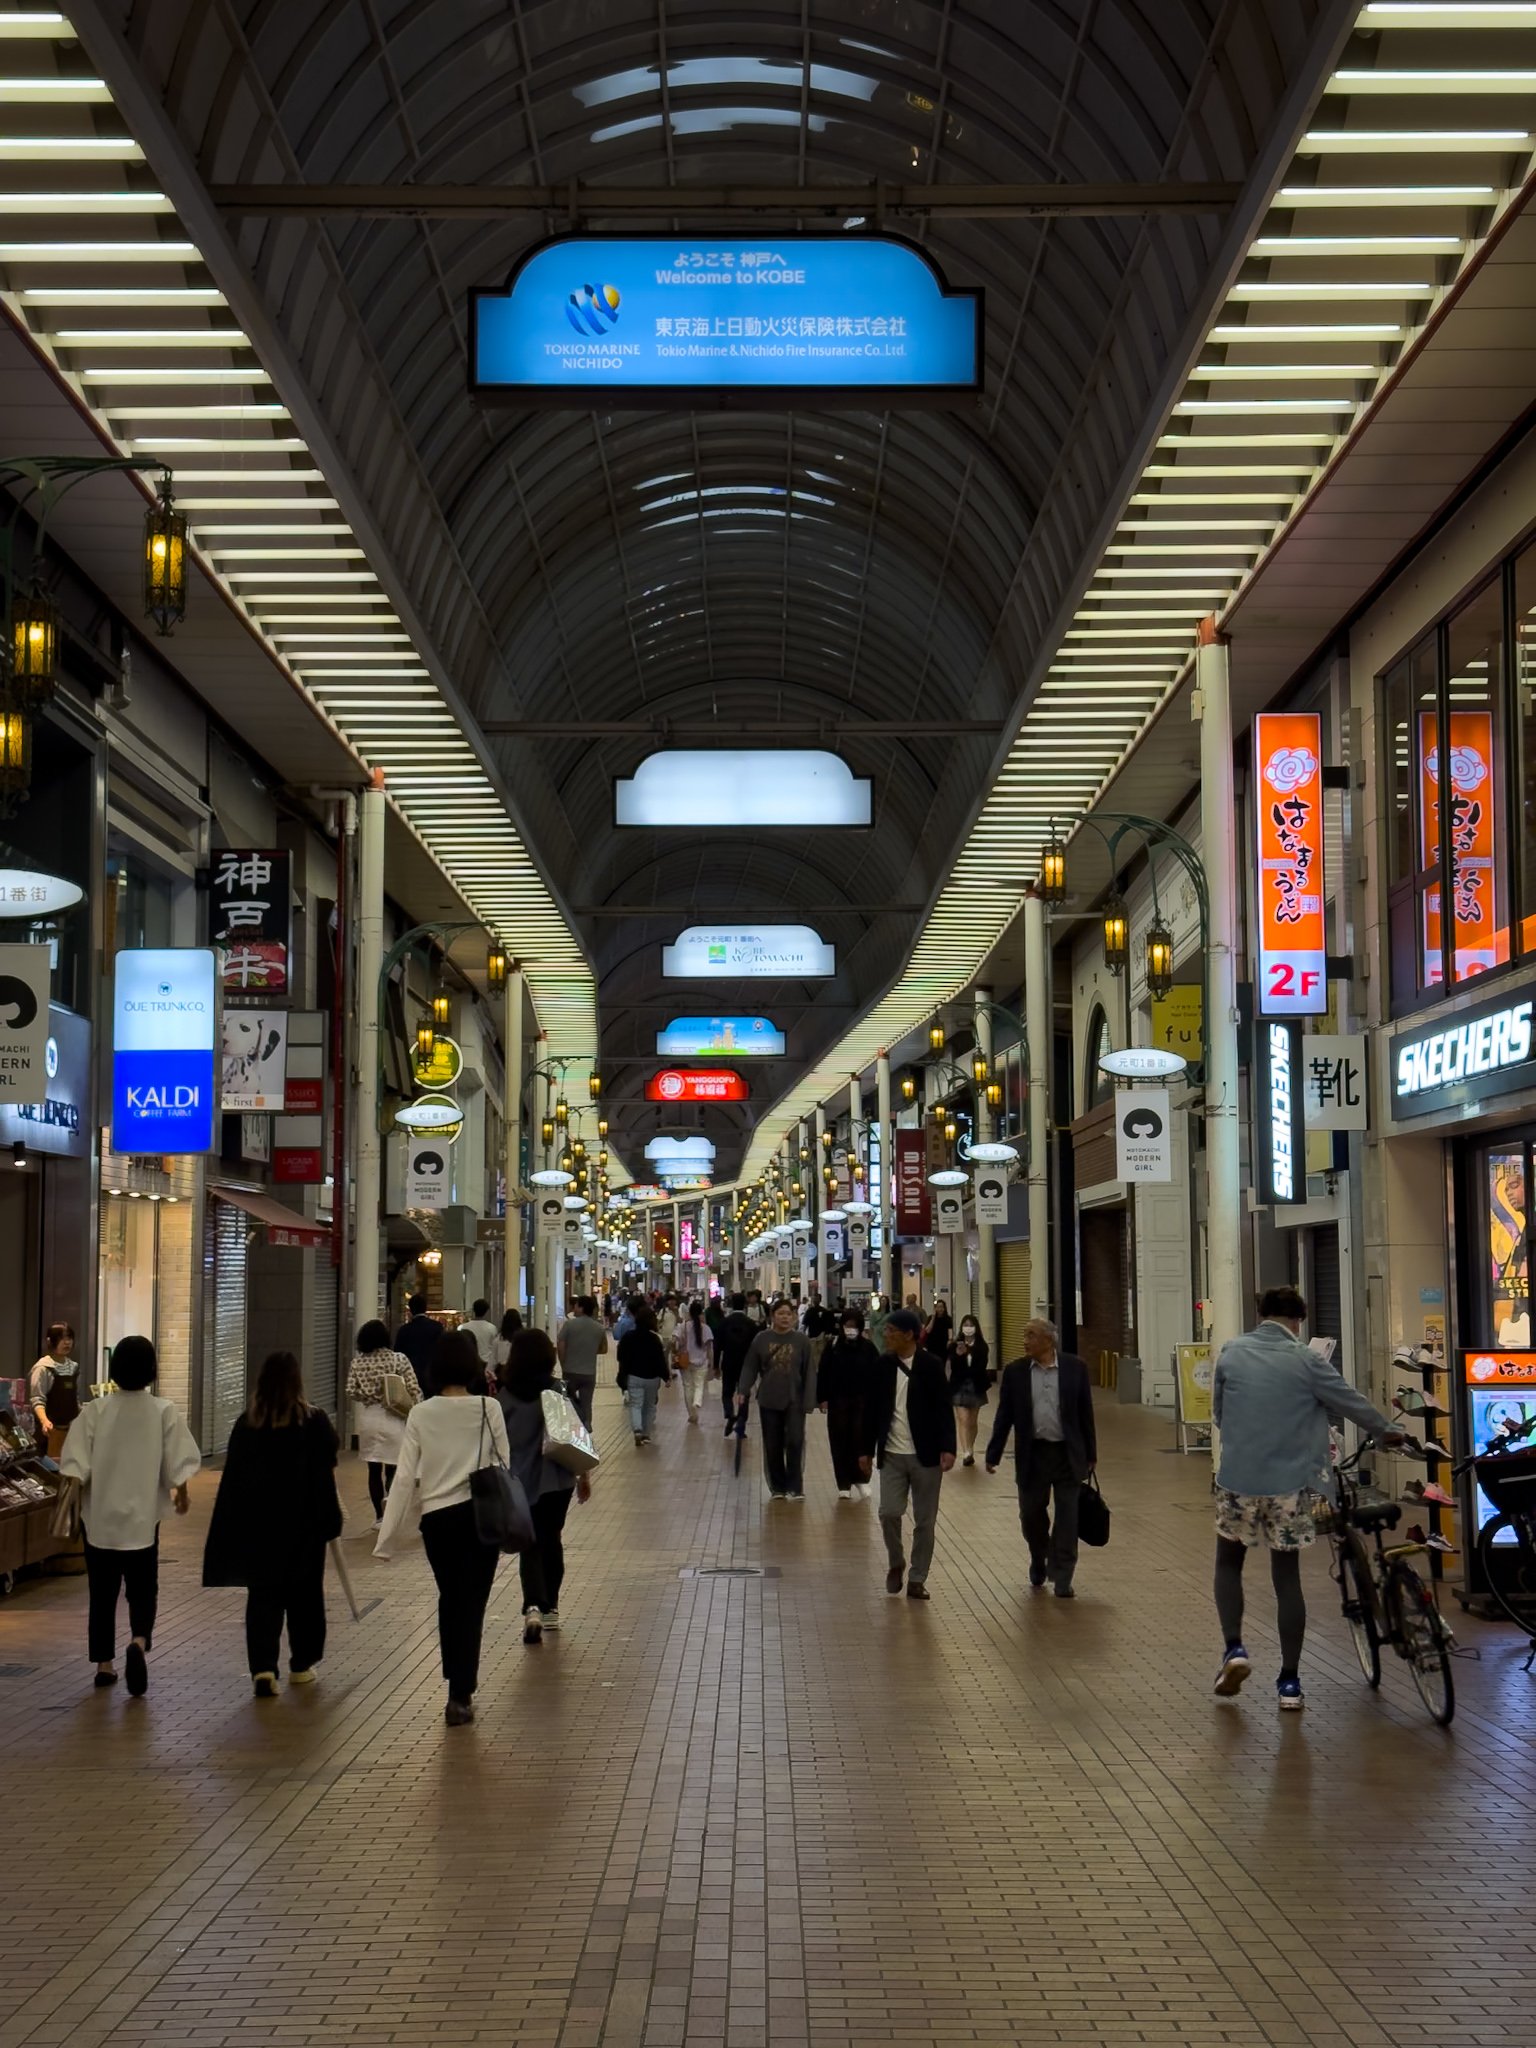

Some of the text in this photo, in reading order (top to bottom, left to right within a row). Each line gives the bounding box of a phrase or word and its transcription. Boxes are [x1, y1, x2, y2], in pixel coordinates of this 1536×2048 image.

[674, 252, 787, 268] ようこそ 神戸へ
[655, 270, 806, 284] Welcome to KOBE
[655, 316, 907, 337] 東京海上日動火災保険株式会社
[544, 344, 641, 356] TOKIO MARINE
[655, 344, 687, 357] Tokio
[688, 344, 728, 357] Marine
[730, 344, 738, 357] &
[740, 344, 784, 357] Nichido
[785, 344, 807, 357] Fire
[808, 344, 862, 357] Insurance
[562, 357, 623, 369] NICHIDO
[214, 852, 272, 988] 神戸牛
[1268, 963, 1320, 996] 2F
[1396, 1001, 1533, 1096] SKECHERS
[1309, 1057, 1360, 1108] 靴
[127, 1086, 199, 1108] KALDI
[1269, 1023, 1294, 1200] SKECHERS
[1126, 1154, 1161, 1162] MODERN
[1134, 1164, 1154, 1172] GIRL
[1498, 1361, 1536, 1377] はなま
